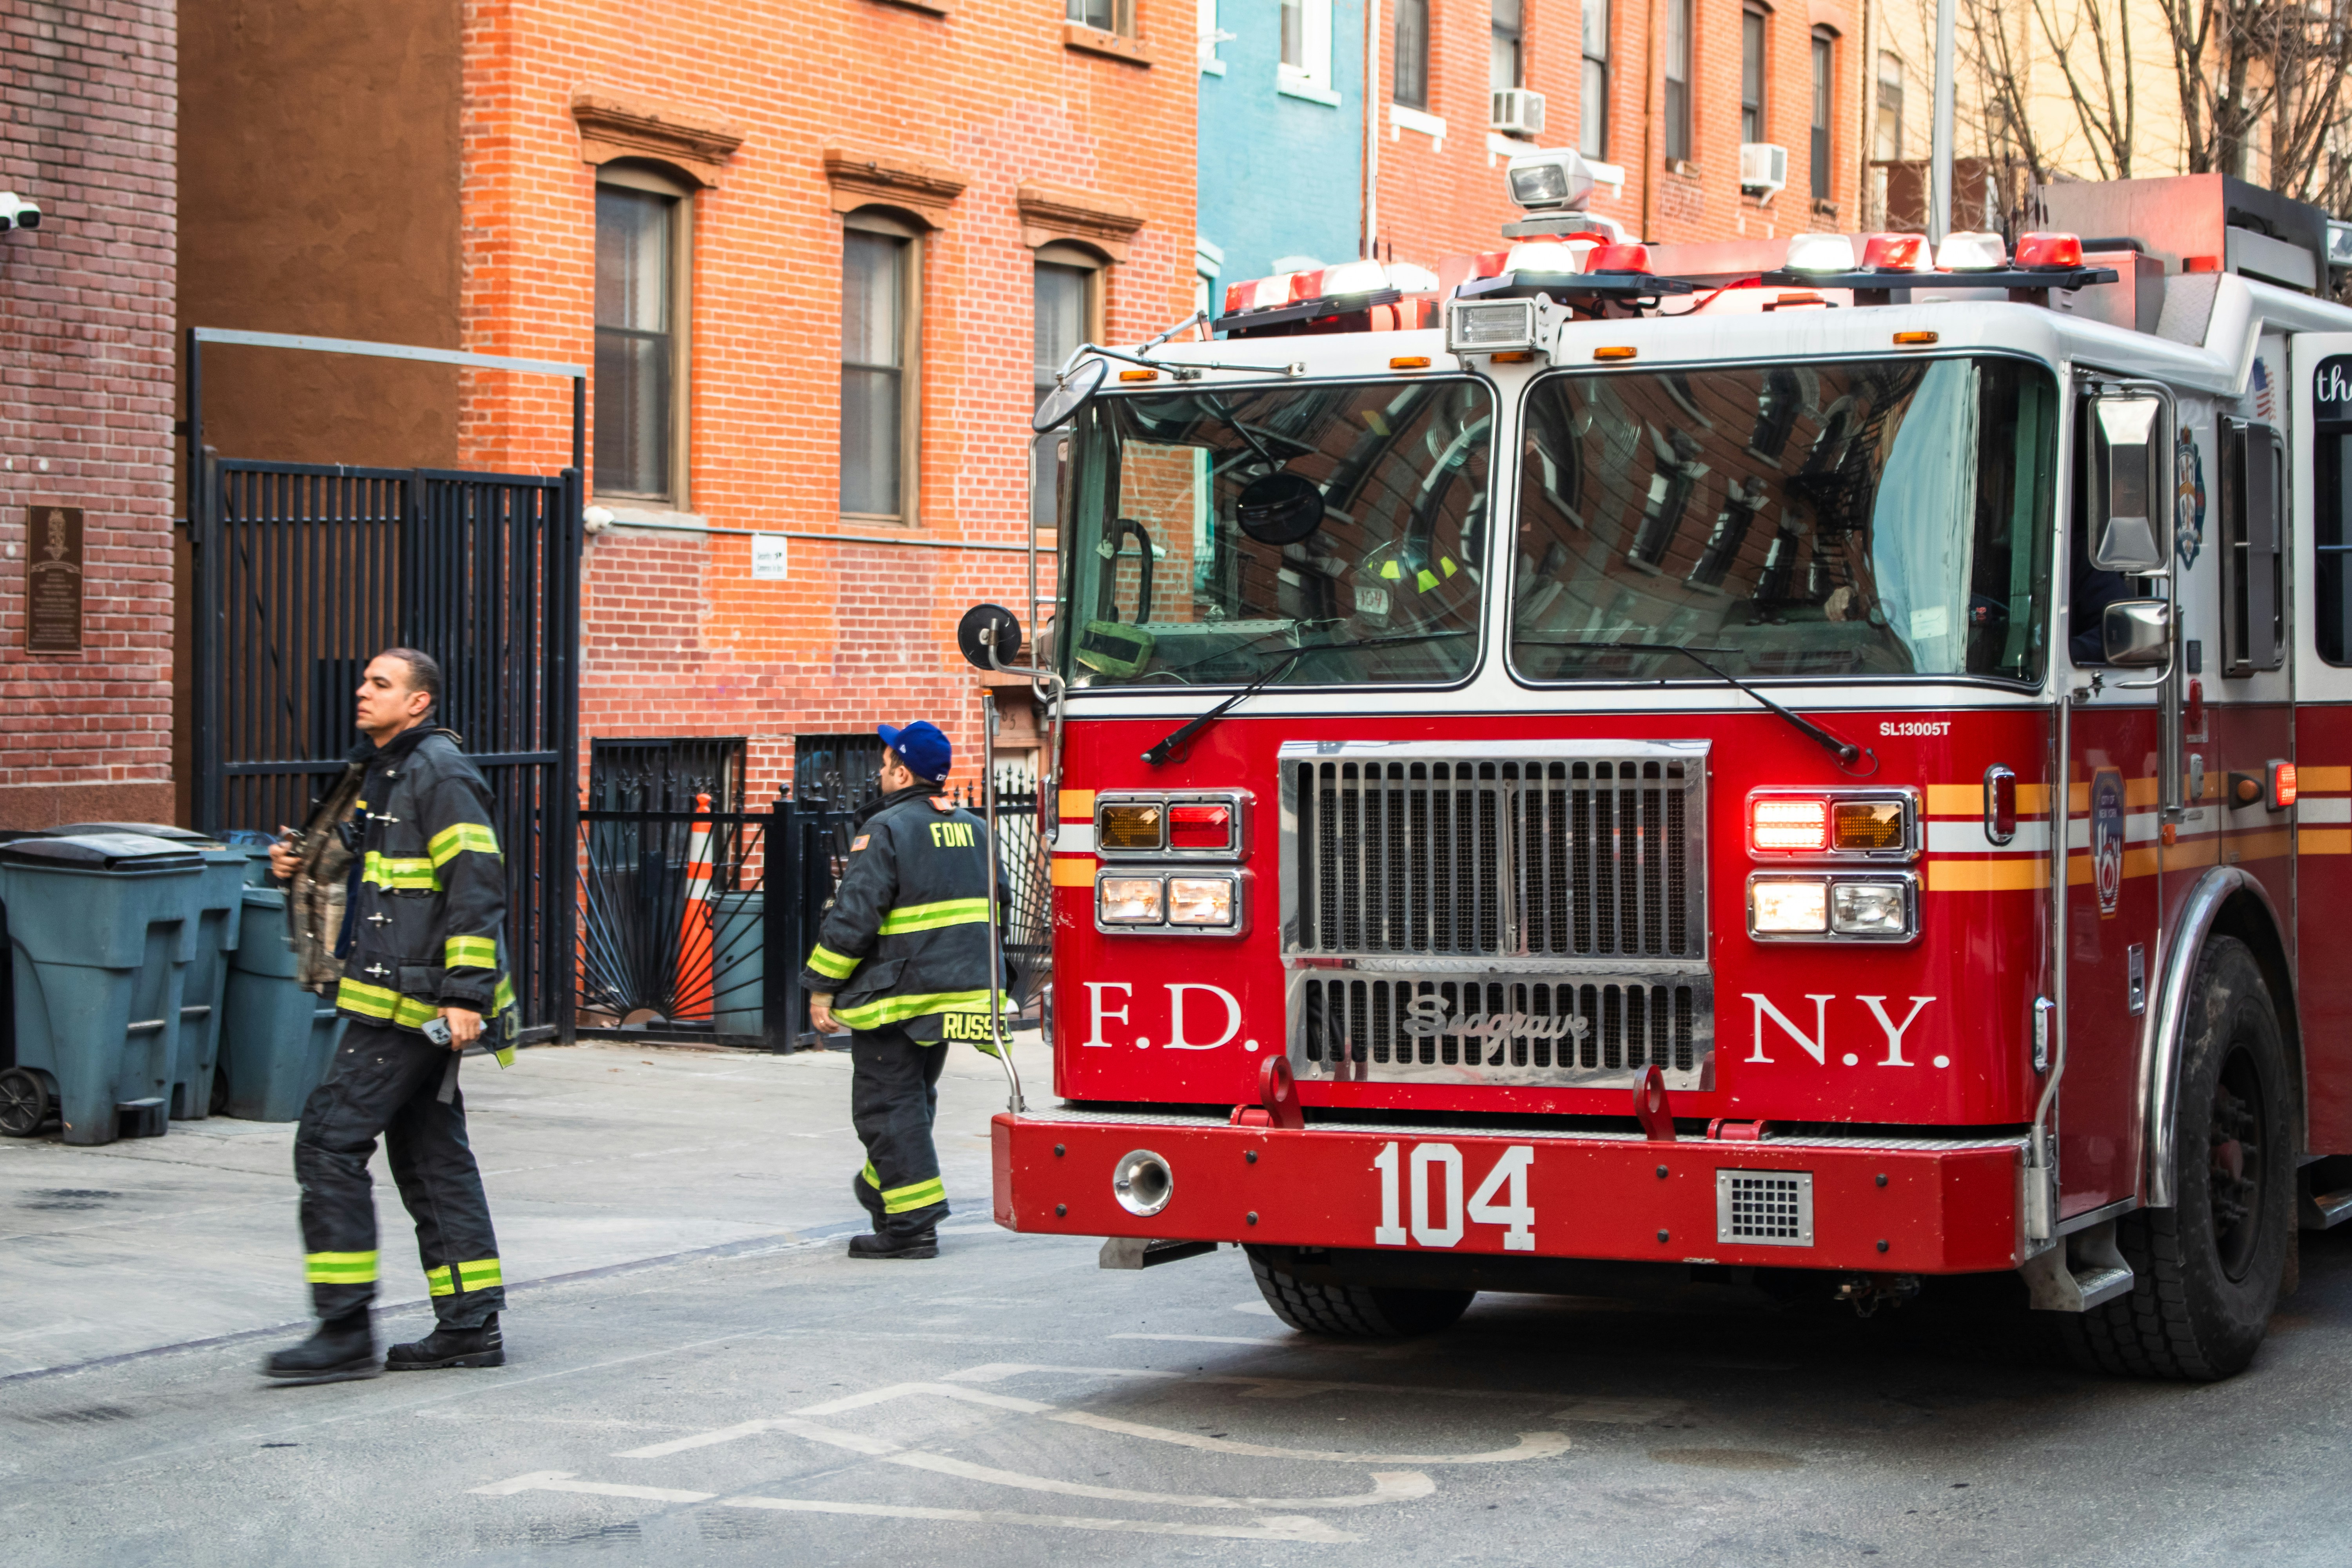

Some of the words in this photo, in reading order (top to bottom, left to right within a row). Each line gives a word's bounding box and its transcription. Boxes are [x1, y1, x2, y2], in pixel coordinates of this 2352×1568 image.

[2316, 364, 2352, 402] th
[1361, 590, 1382, 608] 104
[1880, 722, 1951, 736] SL13005T
[929, 822, 975, 848] FDNY
[1082, 982, 1259, 1052] F.D.
[1741, 993, 1950, 1069] N.Y.
[1403, 994, 1590, 1059] Seagrave
[1374, 1141, 1536, 1252] 104
